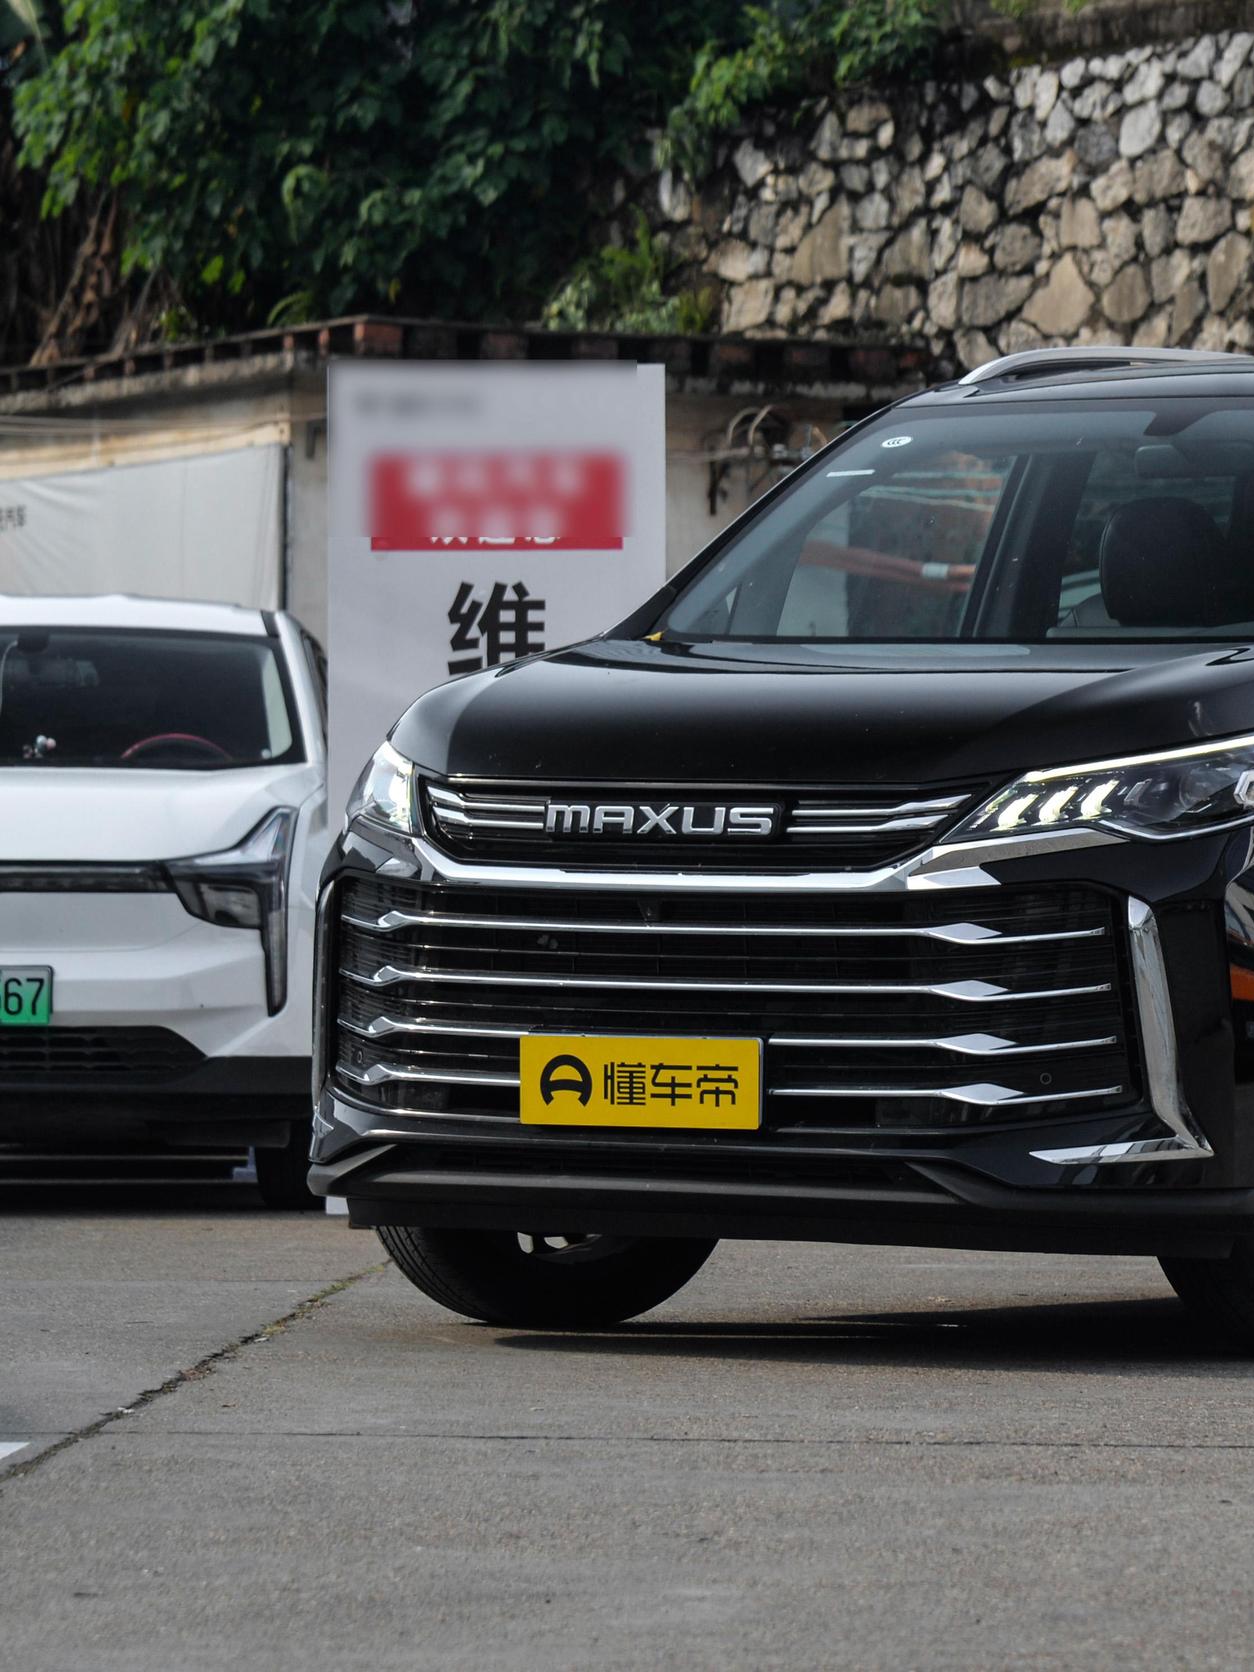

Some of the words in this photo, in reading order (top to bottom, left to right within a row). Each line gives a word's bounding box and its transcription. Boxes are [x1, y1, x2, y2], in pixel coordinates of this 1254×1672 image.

[447, 580, 546, 676] 维
[546, 804, 773, 835] MAXUS
[0, 977, 45, 1016] 67
[603, 1061, 739, 1107] 懂车帝
